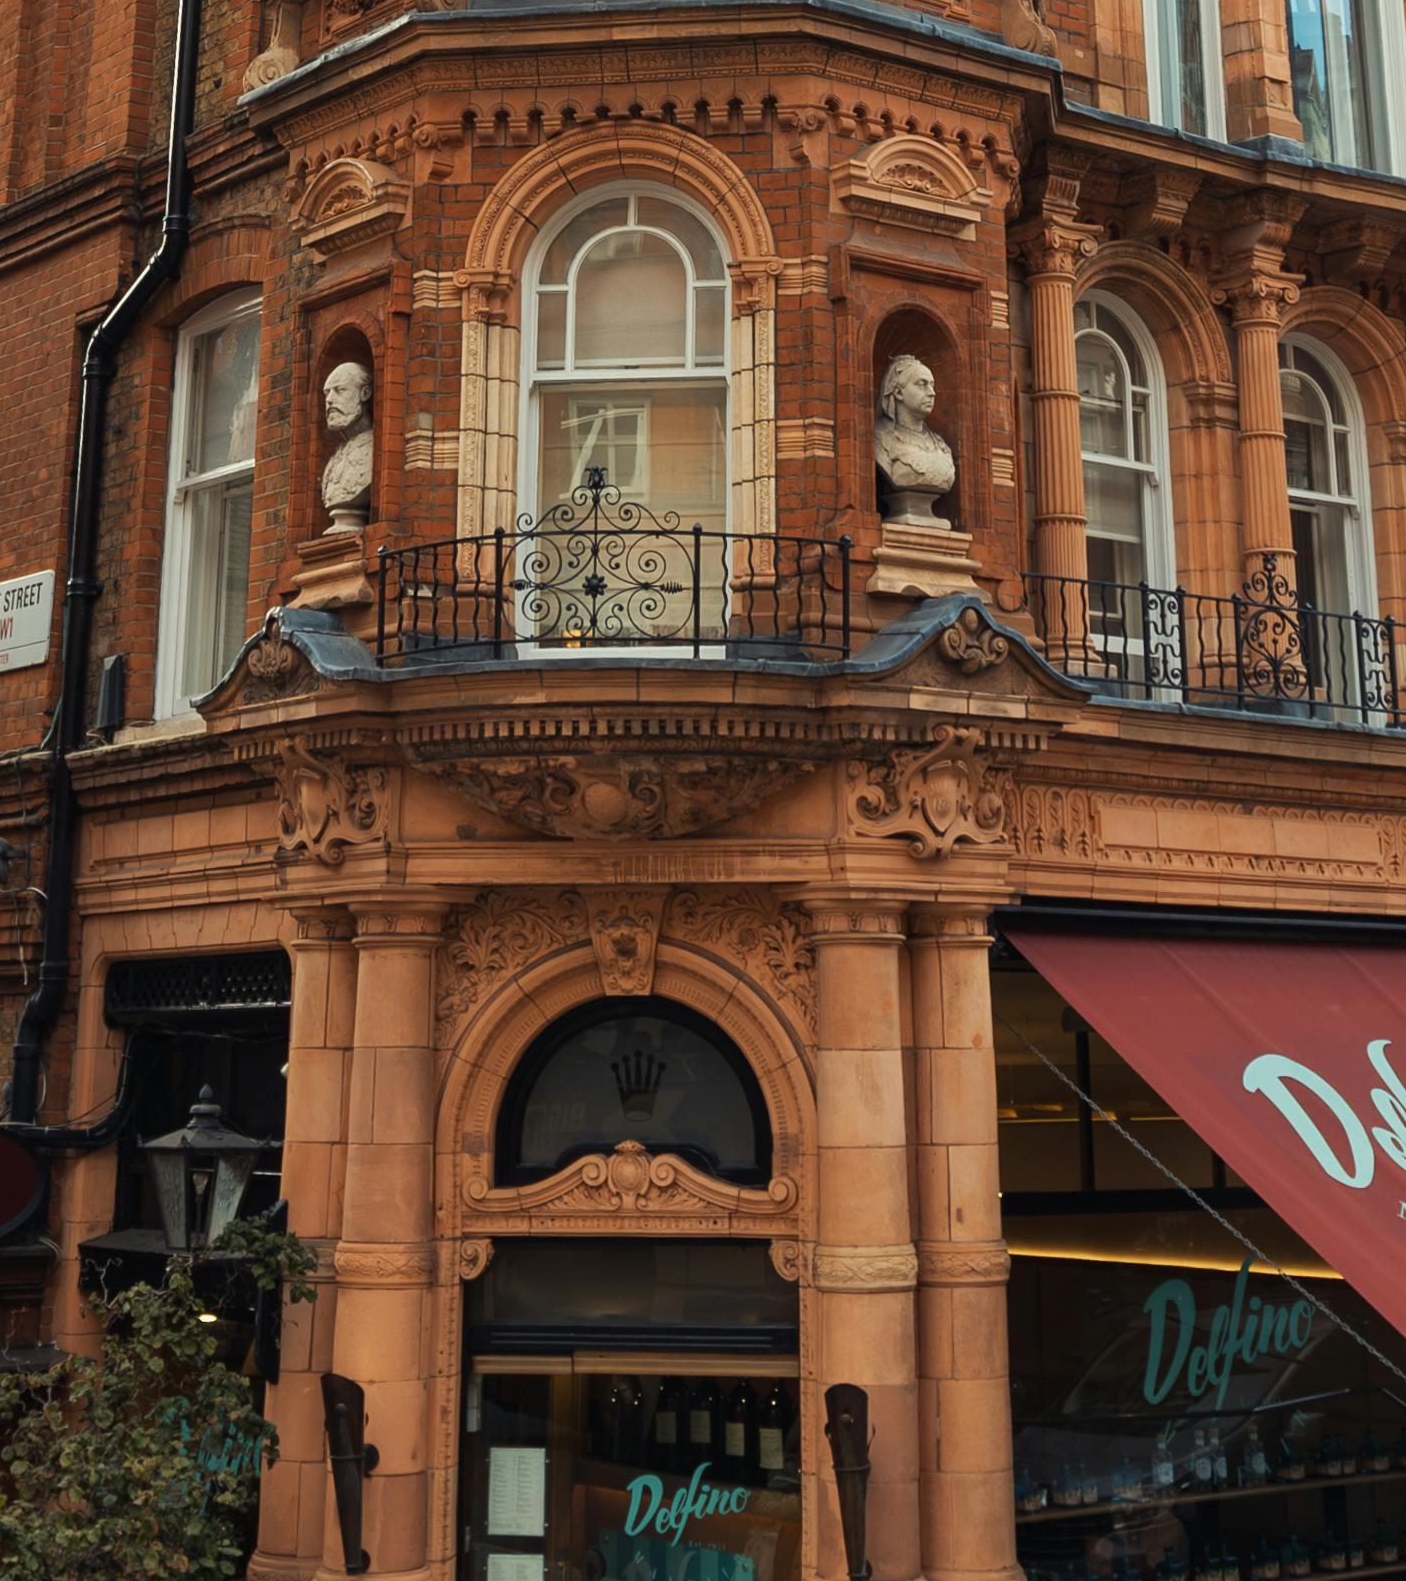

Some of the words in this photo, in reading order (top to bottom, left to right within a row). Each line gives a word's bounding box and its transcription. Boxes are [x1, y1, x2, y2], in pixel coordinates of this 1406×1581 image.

[3, 582, 43, 612] STREET
[0, 617, 14, 640] W1
[1143, 1251, 1315, 1422] Delfino
[624, 1462, 751, 1548] Delfino
